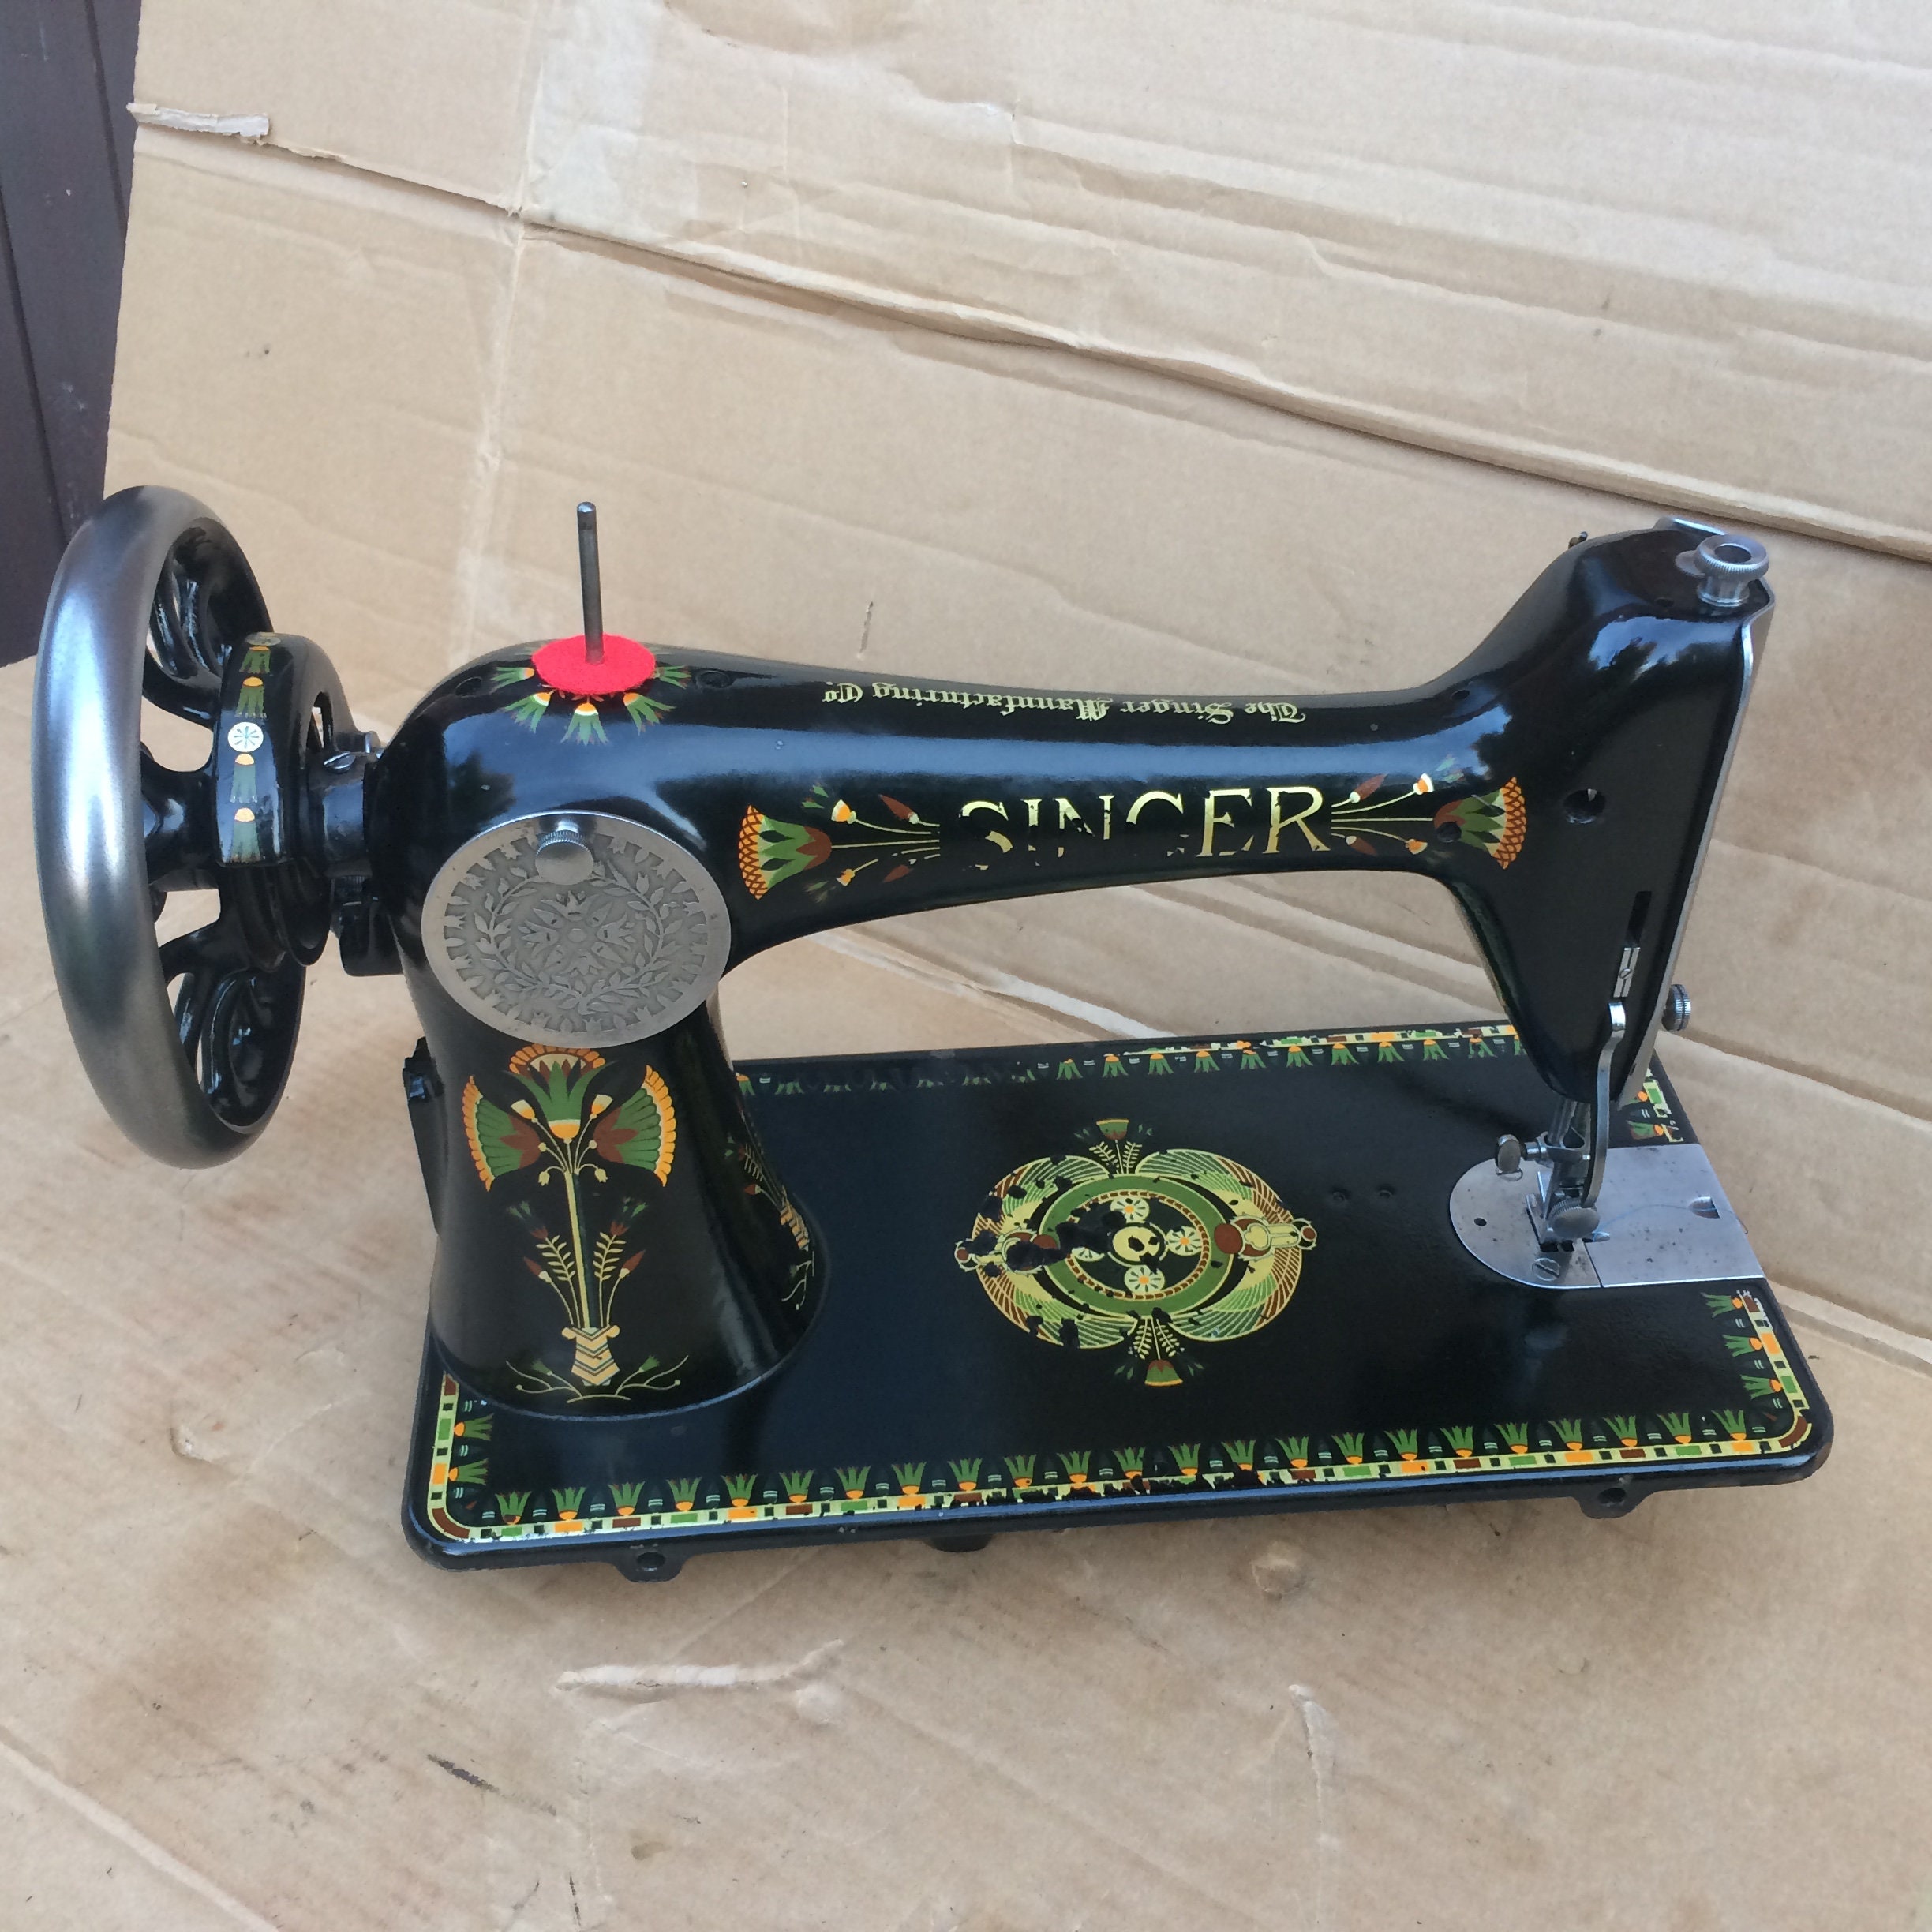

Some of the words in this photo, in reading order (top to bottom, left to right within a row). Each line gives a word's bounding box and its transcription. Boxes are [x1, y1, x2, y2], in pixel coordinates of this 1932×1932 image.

[871, 682, 1114, 722] Manufacturing
[1119, 698, 1234, 724] Singer
[1244, 700, 1307, 723] The
